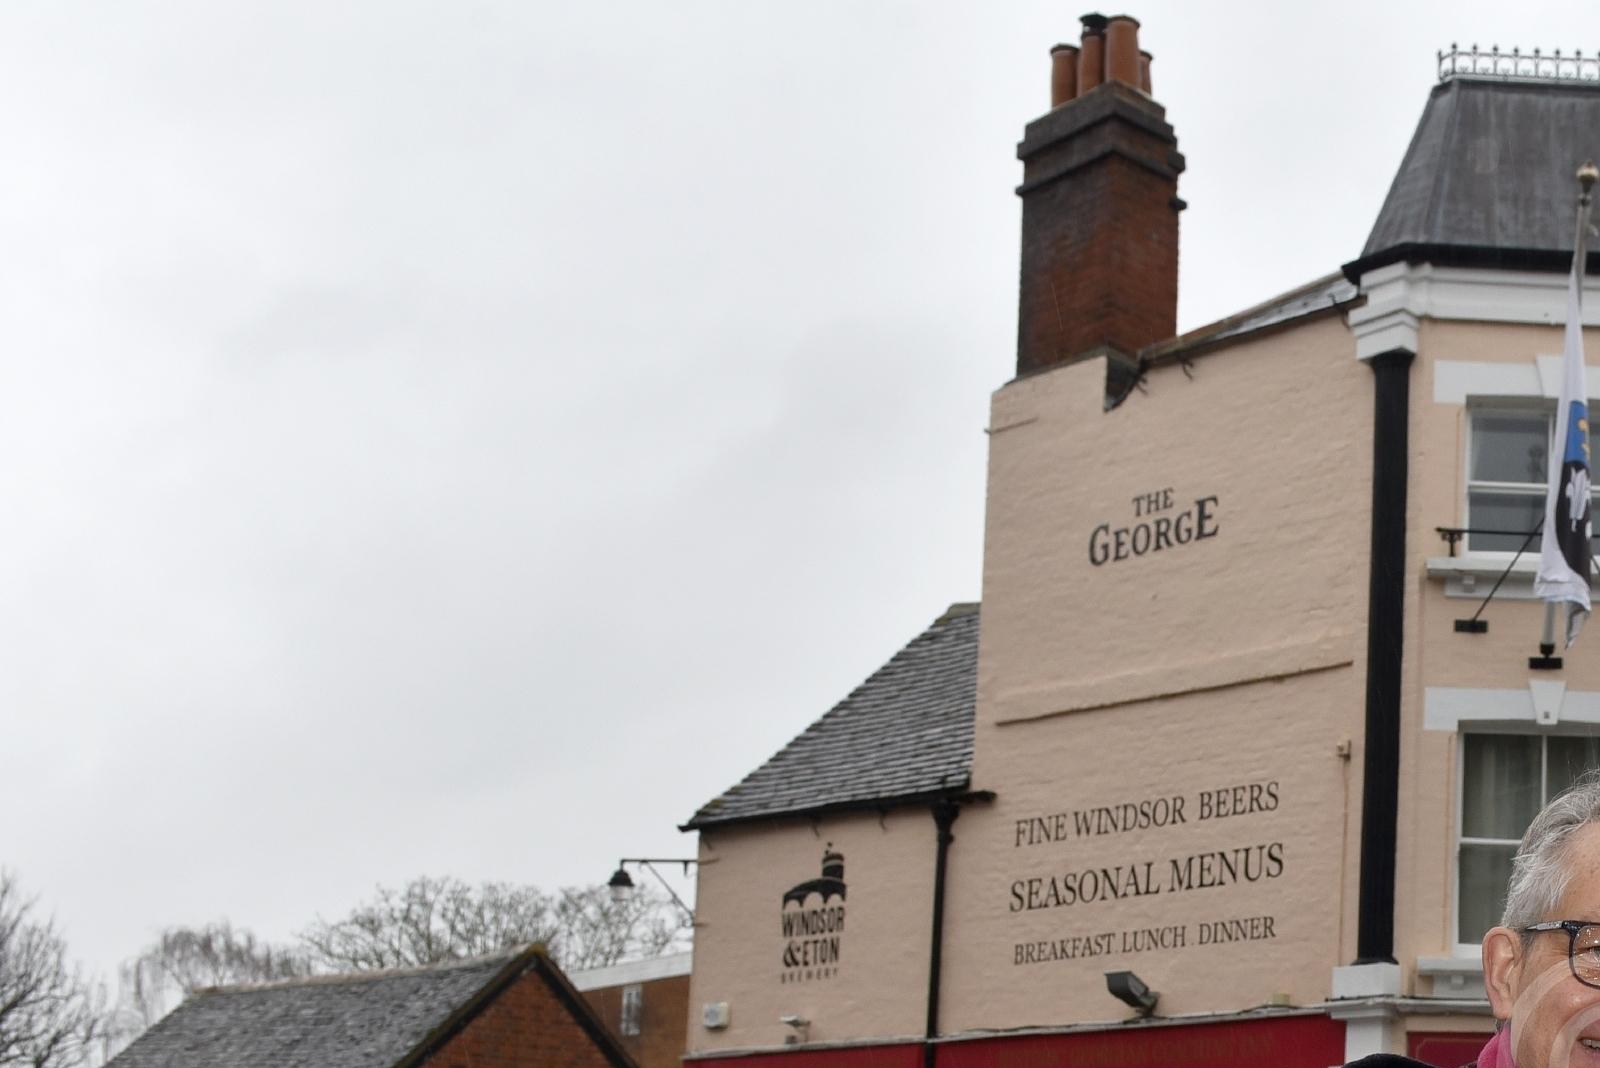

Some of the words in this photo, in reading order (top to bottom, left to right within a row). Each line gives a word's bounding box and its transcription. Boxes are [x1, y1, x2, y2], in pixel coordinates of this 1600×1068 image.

[1132, 487, 1174, 517] THE
[1088, 495, 1219, 566] GEORGE
[1014, 813, 1067, 847] FINE
[1073, 796, 1187, 837] WINDSOR
[1198, 781, 1280, 821] BEERS
[1009, 862, 1161, 912] SEASONAL
[1167, 842, 1285, 893] MENUS
[782, 906, 845, 937] WINDSOR
[1198, 916, 1276, 945] DINNER
